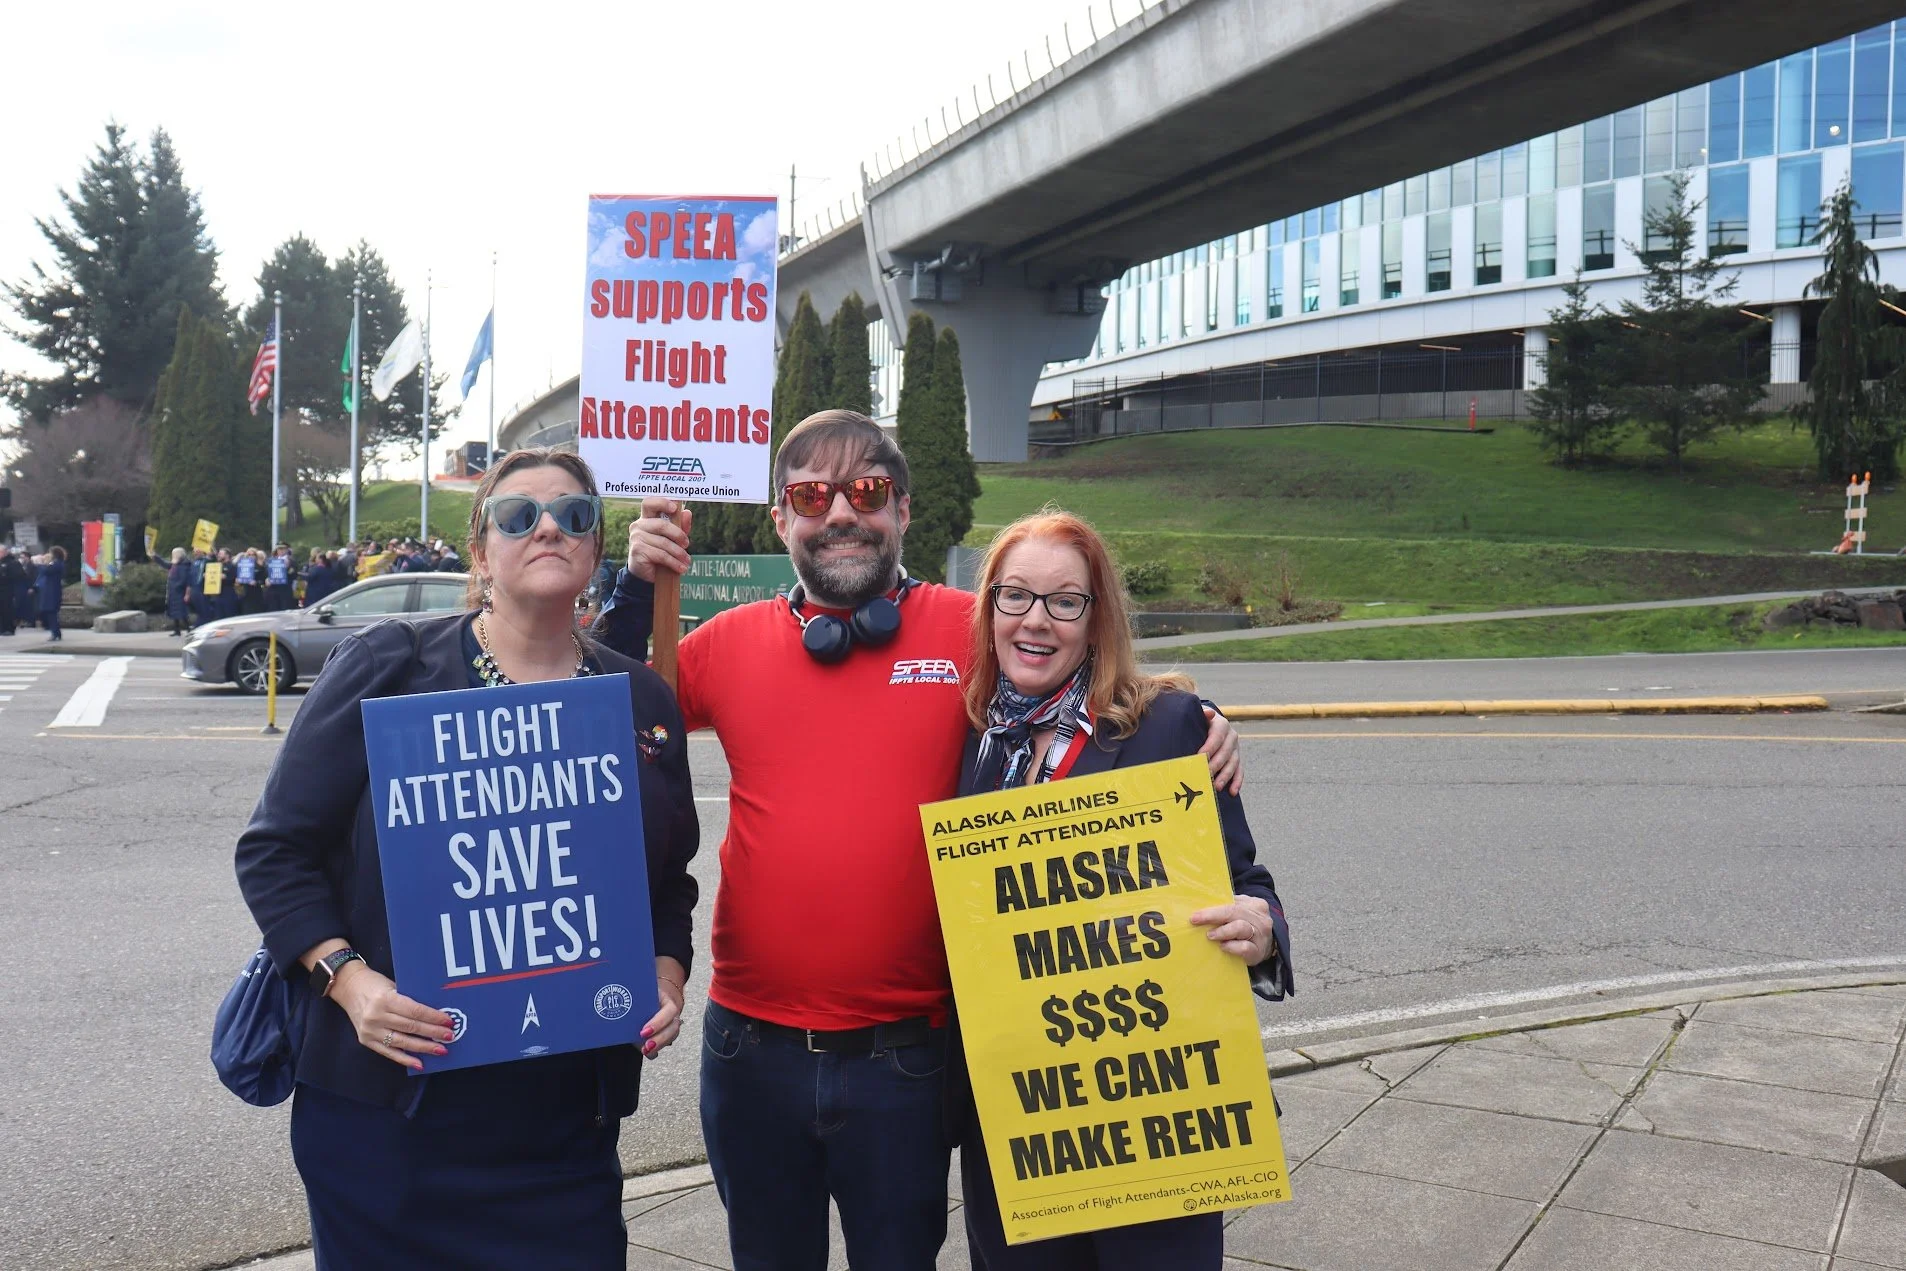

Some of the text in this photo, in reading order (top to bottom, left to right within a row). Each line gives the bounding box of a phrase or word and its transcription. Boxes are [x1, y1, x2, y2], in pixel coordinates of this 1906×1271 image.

[624, 210, 737, 260] SPEEA
[590, 277, 767, 324] supports
[625, 339, 727, 388] Flight
[580, 397, 769, 445] Attendants
[605, 481, 740, 497] Professional Aerospace Union
[641, 456, 706, 476] SPEEA
[679, 583, 766, 602] ERNATIONAL AIRPORT
[891, 659, 960, 678] SPEEA
[432, 701, 563, 764] FLIGHT
[387, 753, 623, 828] ATTENDANTS
[932, 790, 1119, 837] ALASKA AIRLINES
[448, 820, 578, 900] SAVE
[936, 809, 1163, 861] FLIGHT ATTENDANTS
[993, 839, 1170, 915] ALASKA
[440, 894, 602, 978] LIVES!
[1013, 911, 1171, 981] MAKES
[1040, 979, 1170, 1047] $$$$
[1011, 1039, 1221, 1115] WE CAN'T
[1008, 1100, 1253, 1181] MAKE RENT
[1011, 1205, 1075, 1222] Association
[1078, 1199, 1089, 1210] of
[1092, 1196, 1123, 1209] Flight
